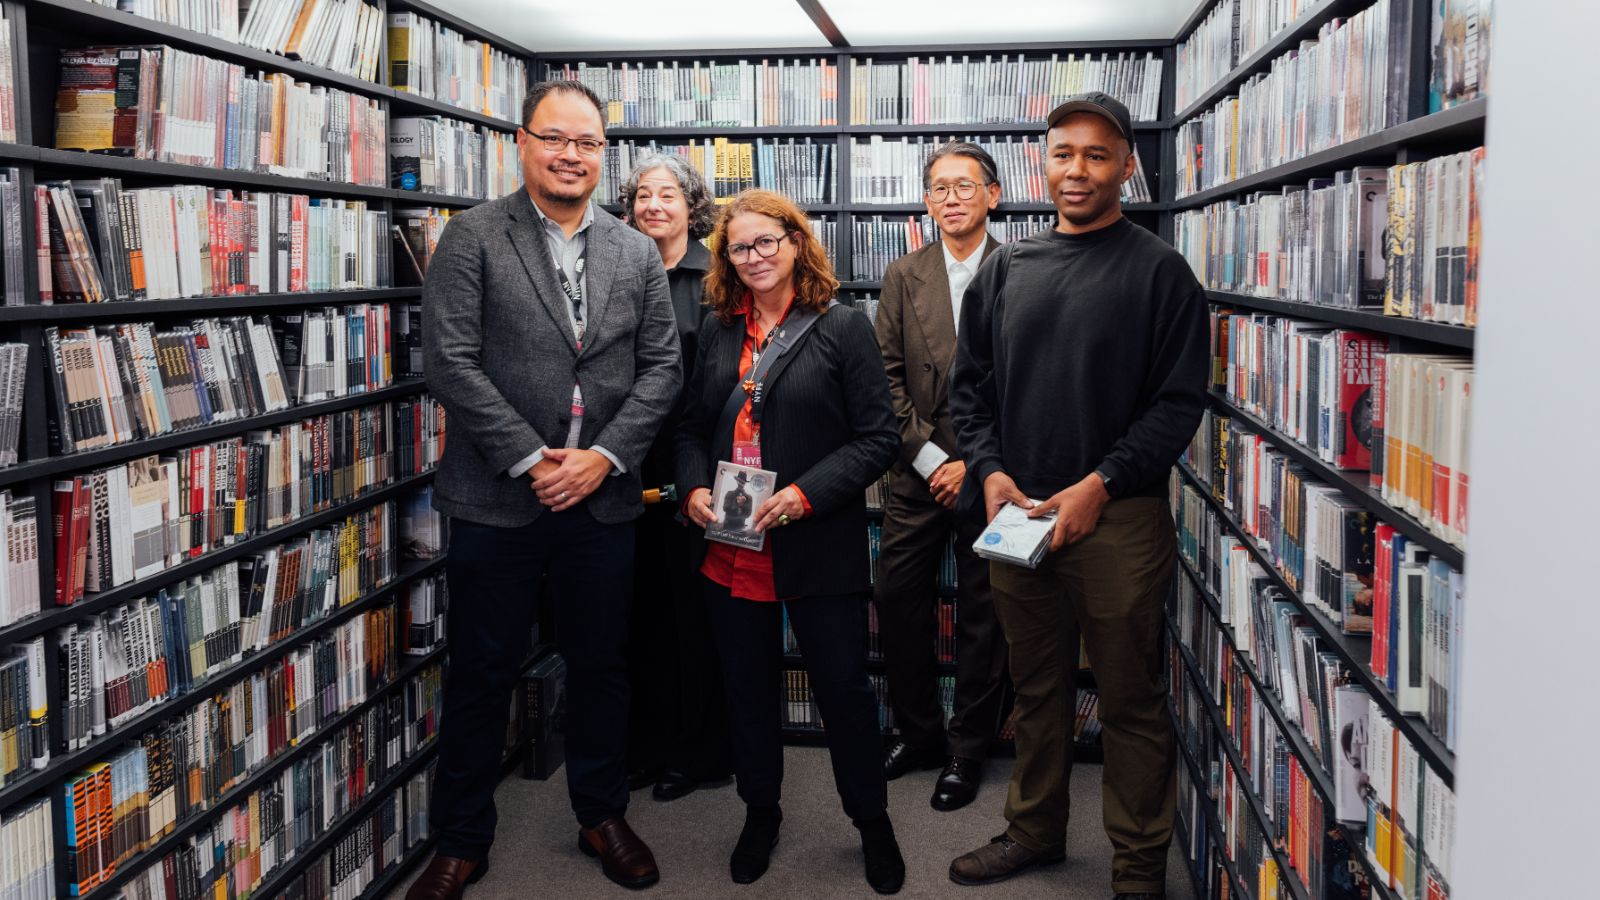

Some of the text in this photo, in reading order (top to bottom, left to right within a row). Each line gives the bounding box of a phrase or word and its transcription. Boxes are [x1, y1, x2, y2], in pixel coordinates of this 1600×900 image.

[51, 334, 63, 374] NAKED
[64, 350, 73, 371] NAKED
[72, 349, 80, 370] NAKED
[85, 347, 94, 368] NAKED
[9, 370, 18, 404] GARDENS
[93, 474, 102, 520] KOKO
[100, 474, 110, 518] KOKO
[121, 609, 134, 669] BRUTE FORCE
[132, 645, 141, 669] FORCE
[136, 618, 146, 666] BRUTE FORCE
